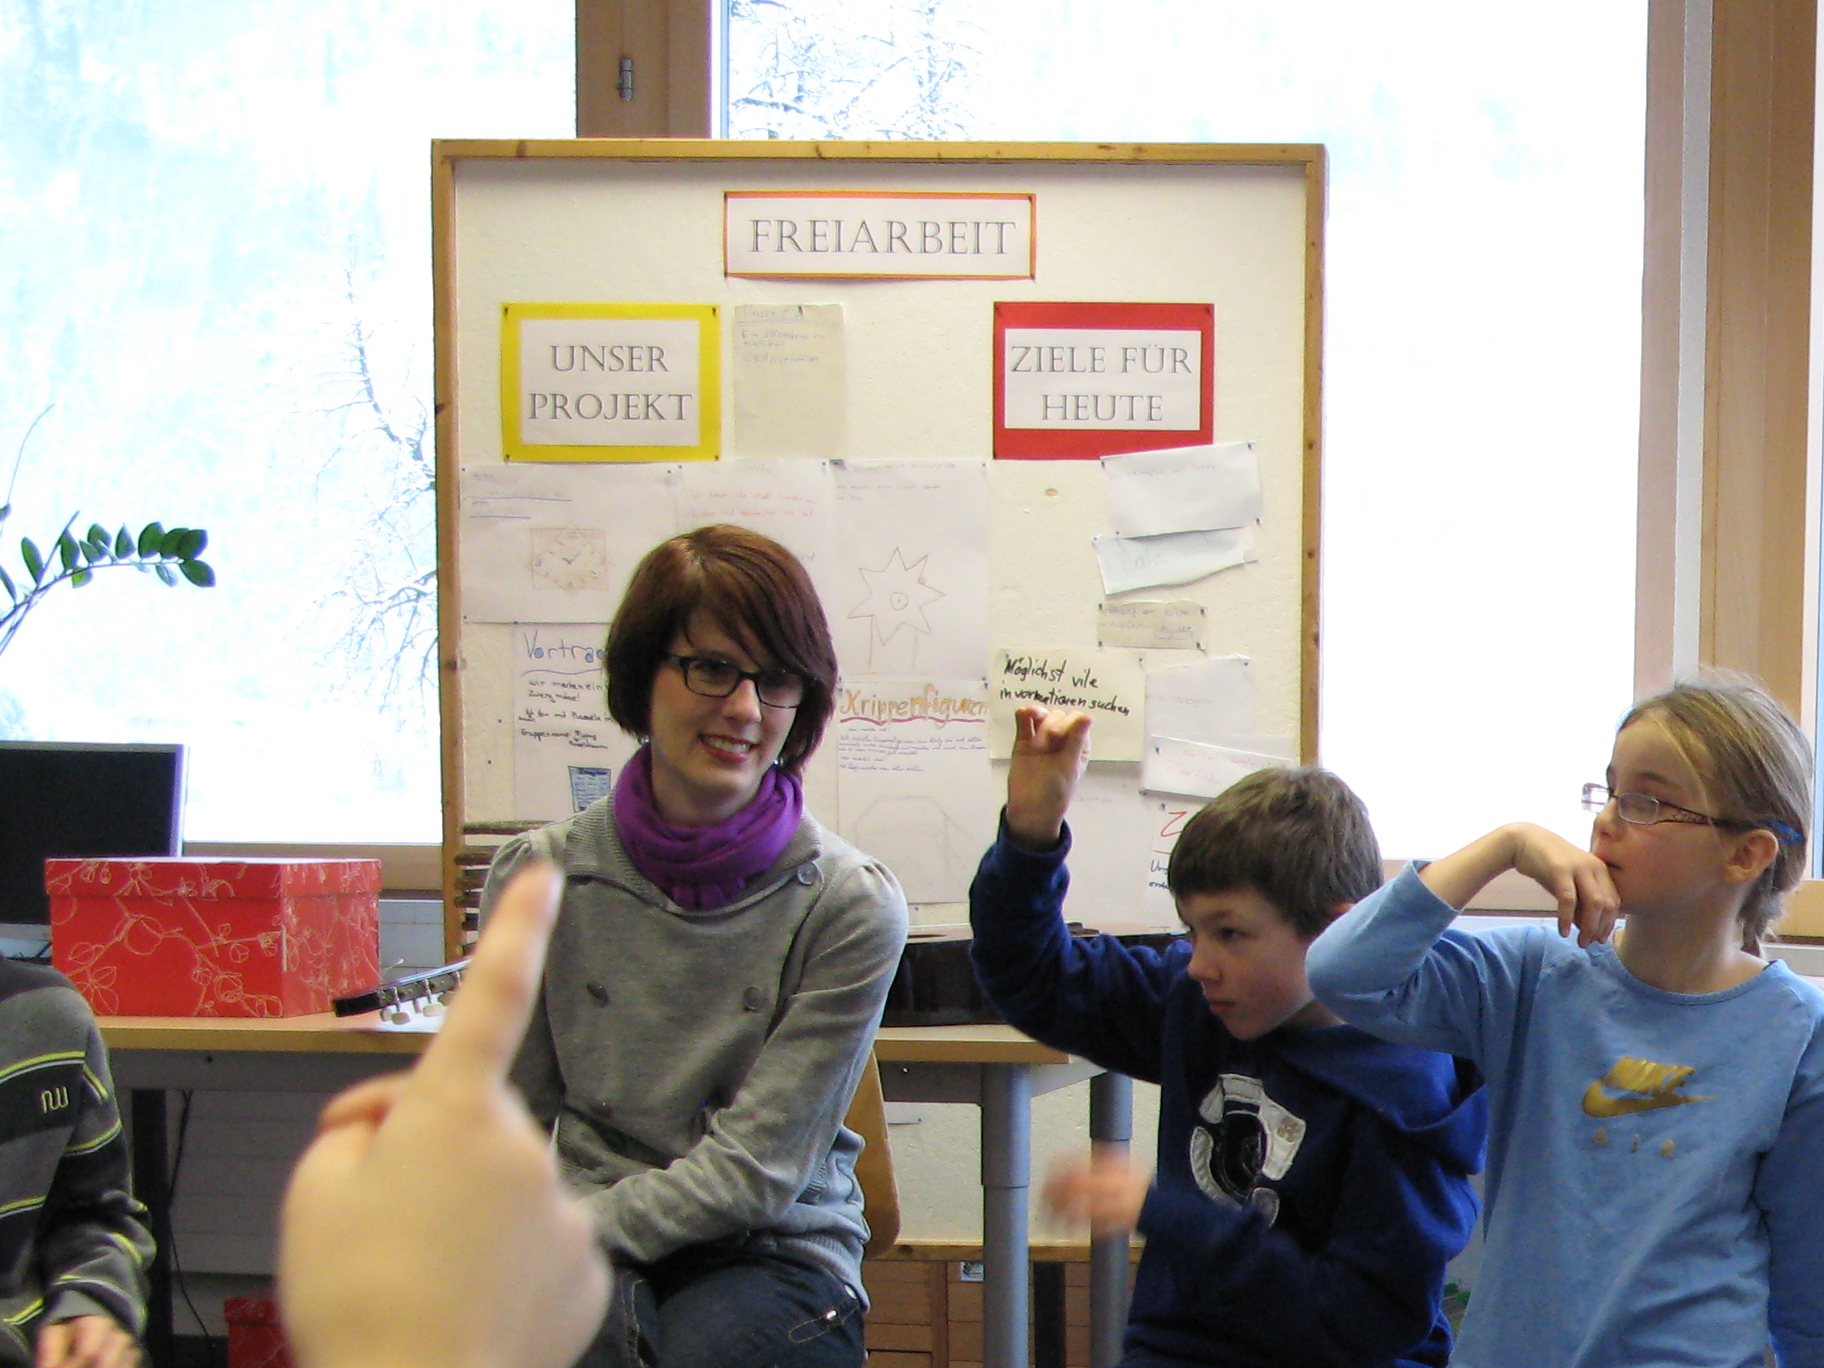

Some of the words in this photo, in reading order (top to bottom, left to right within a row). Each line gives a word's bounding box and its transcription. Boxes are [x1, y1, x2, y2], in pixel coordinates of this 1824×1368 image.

[749, 218, 1017, 255] FREIARBEIT
[550, 345, 670, 373] UNSER
[1010, 345, 1107, 374] ZIELE
[1120, 343, 1193, 375] FÜR
[528, 392, 693, 421] PROJEKT
[1041, 393, 1164, 422] HEUTE
[1003, 656, 1068, 682] Möglichst
[1071, 667, 1100, 689] vile
[1088, 695, 1131, 717] suchen
